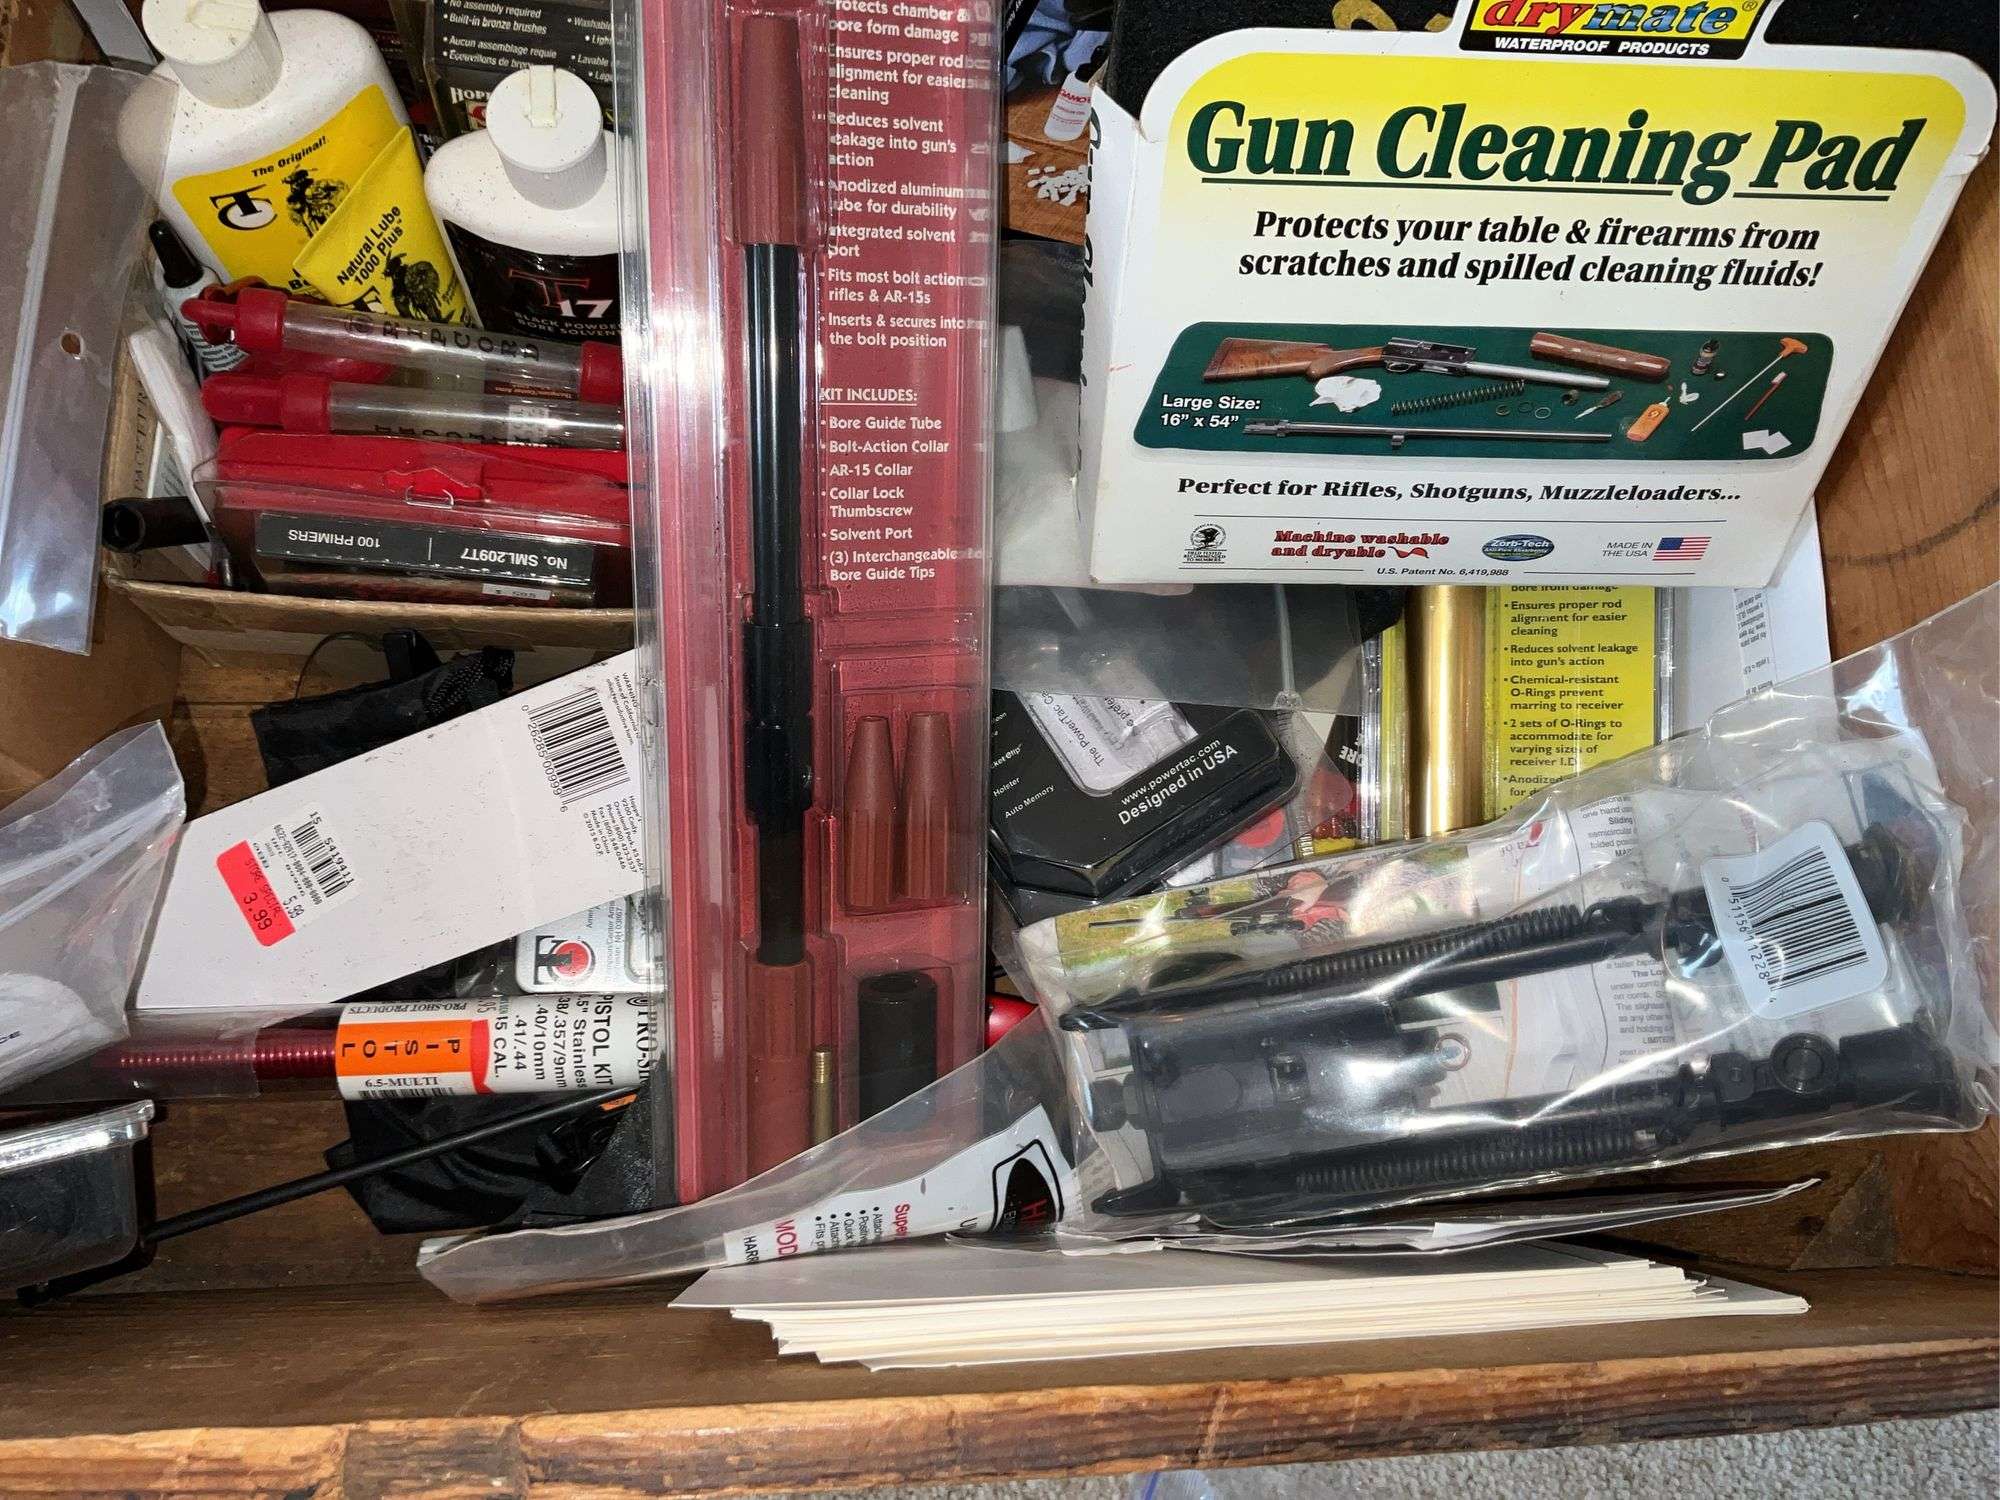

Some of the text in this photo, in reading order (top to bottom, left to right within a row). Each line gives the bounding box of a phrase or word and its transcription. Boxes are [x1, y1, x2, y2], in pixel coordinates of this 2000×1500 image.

[463, 2, 541, 19] assembly required
[892, 2, 953, 21] chamber
[1484, 0, 1736, 35] drymate
[450, 13, 547, 34] Built-in bronze brushes
[867, 19, 959, 44] form damage
[478, 42, 528, 55] assemblage
[1495, 37, 1710, 56] WATERPROOF PRODUCTS
[887, 51, 963, 68] proper rod
[902, 70, 922, 85] for
[892, 116, 943, 132] solvent
[889, 134, 956, 154] into gun's
[1186, 100, 1928, 205] Gun Cleaning Pad
[252, 136, 327, 178] The Original!
[900, 181, 964, 198] aluminum
[867, 198, 957, 221] for durability
[907, 228, 956, 243] solvent
[1253, 210, 1821, 250] Protects your table & firearms from
[336, 205, 402, 286] Natural Lube
[353, 258, 382, 286] 1000
[828, 268, 964, 286] Fits most bolt action
[1238, 249, 1824, 291] scratches and spilled cleaning fluids!
[828, 288, 931, 304] rifles & AR-15s
[828, 313, 966, 330] Inserts & secures into
[829, 332, 947, 348] the bolt position
[820, 388, 918, 401] KIT INCLUDES:
[1162, 394, 1261, 411] Large Size:
[829, 416, 942, 429] Bore Guide Tube
[1193, 417, 1204, 428] x
[829, 440, 949, 453] Bolt-Action Collar
[829, 463, 913, 476] AR-15 Collar
[830, 486, 904, 500] Collar Lock
[1177, 478, 1742, 502] Perfect for Rifles, Shotguns, Muzzleloaders...
[830, 505, 913, 518] Thumbscrew
[288, 528, 381, 549] 100 PRIMERS
[830, 527, 912, 540] Solvent Port
[1274, 530, 1450, 545] Machine washable
[1490, 539, 1549, 548] Zorb-Tech
[461, 547, 568, 569] No. SML209T7
[830, 548, 958, 566] (3) Interchangeable
[1270, 545, 1386, 560] and dryable
[830, 566, 935, 580] Bore Guide Tips
[1376, 567, 1510, 577] U.S. Patent No. 6,419,988
[1511, 600, 1622, 611] Ensures proper rod
[1511, 613, 1628, 625] alignment for easier
[1511, 627, 1558, 637] cleaning
[1511, 644, 1638, 654] Reduces solvent leakage
[1511, 657, 1604, 668] into gun's action
[1511, 675, 1619, 684] Chemical-resistant
[1511, 688, 1604, 700] O-Rings prevent
[1511, 702, 1624, 712] marring to receiver
[1510, 719, 1622, 729] 2 sets of O-Rings to
[1050, 703, 1106, 768] The PowerTac
[1596, 733, 1613, 741] for
[1510, 745, 1599, 755] varying of
[520, 704, 569, 814] 0 26285 00999 6
[1510, 758, 1556, 766] receiver
[1121, 737, 1221, 806] www.powertac.com
[993, 776, 1021, 797] Holster
[1118, 744, 1238, 826] Designed in USA
[1004, 785, 1055, 819] Auto Memory
[308, 810, 356, 887] 15 5419411
[241, 890, 274, 933] 3.99
[281, 894, 306, 921] 5.99
[592, 994, 613, 1057] PISTOL
[514, 1015, 526, 1071] .41/.44
[534, 1004, 546, 1080] .40/10mm
[494, 1037, 507, 1078] CAL.
[573, 1019, 588, 1088] Stainless
[365, 1076, 440, 1088] 6.5-MULTI
[594, 1064, 613, 1086] KIT
